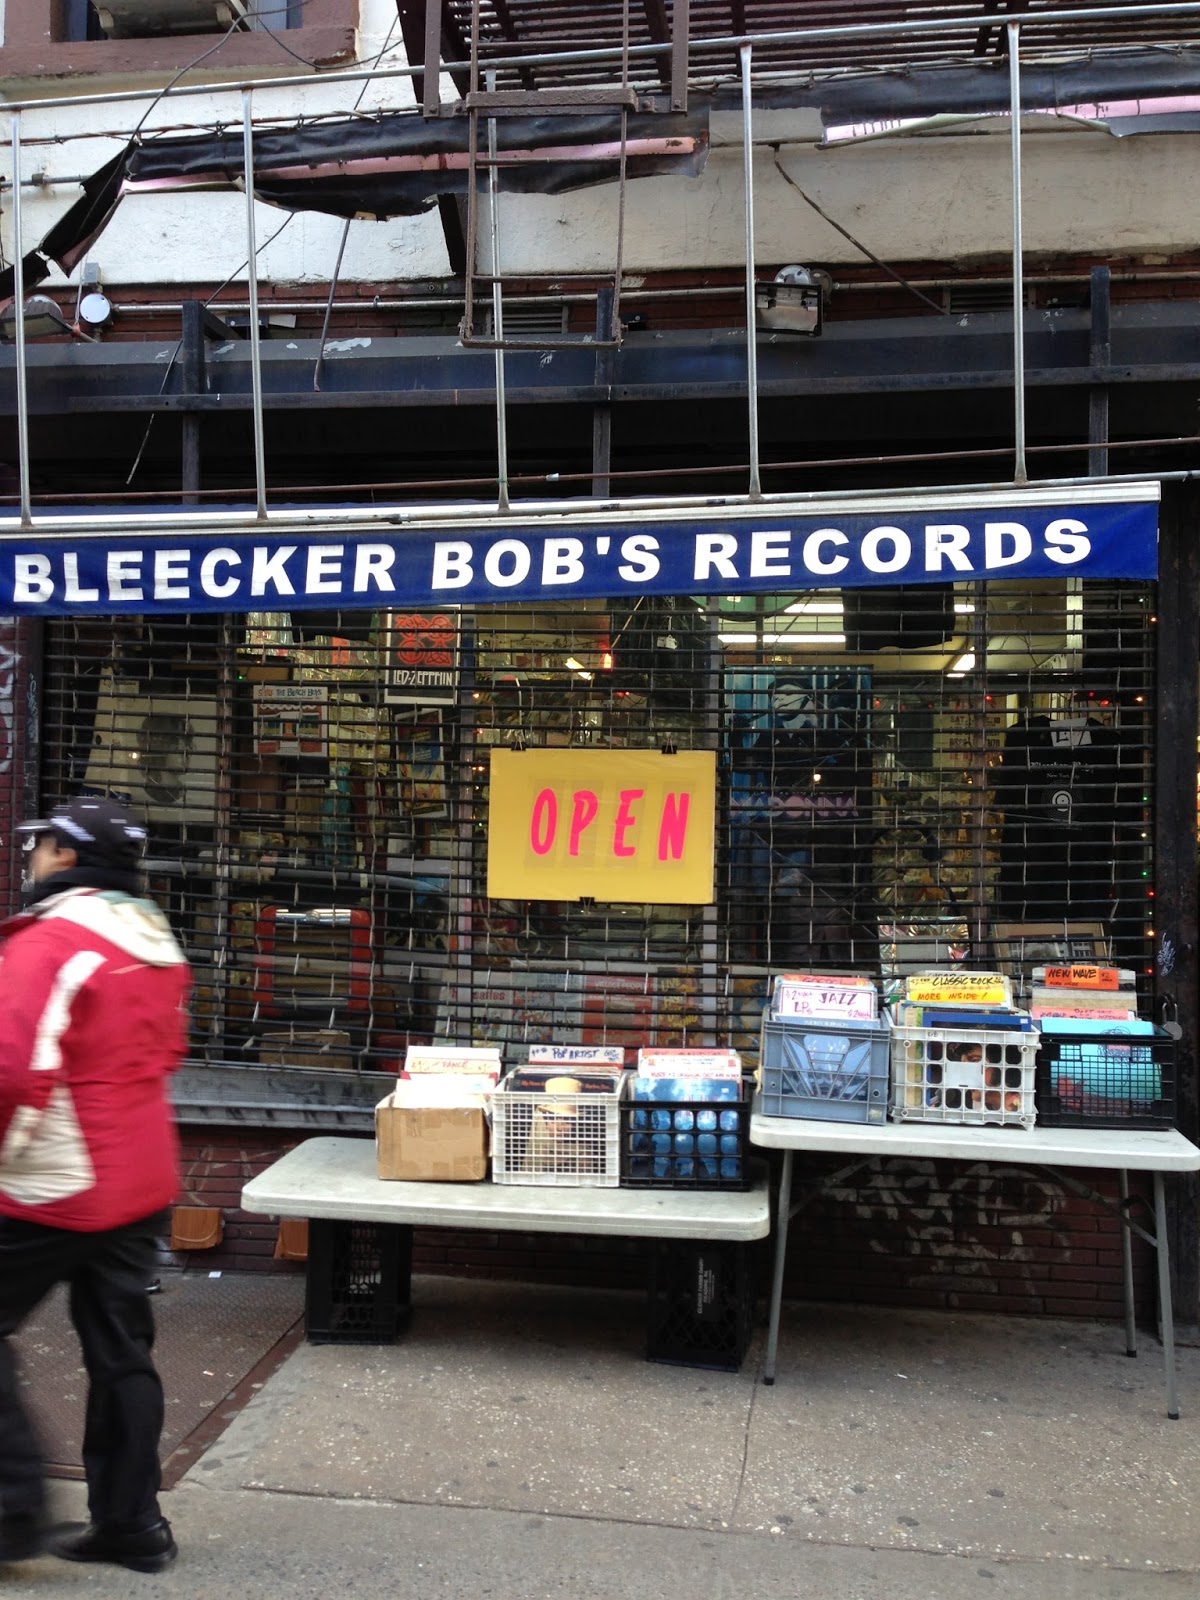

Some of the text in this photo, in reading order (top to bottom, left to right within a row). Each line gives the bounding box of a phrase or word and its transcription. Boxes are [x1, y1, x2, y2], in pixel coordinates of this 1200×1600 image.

[13, 518, 1091, 602] BLEECKER BOB'S RECORDS
[730, 796, 859, 817] MADONNA
[530, 788, 690, 861] OPEN
[1048, 968, 1097, 979] NEW WAVE
[932, 976, 969, 987] CLASSIC
[970, 976, 994, 985] ROCK
[819, 992, 858, 1006] JAZZ
[917, 992, 941, 1001] MORE
[552, 1047, 568, 1059] POP
